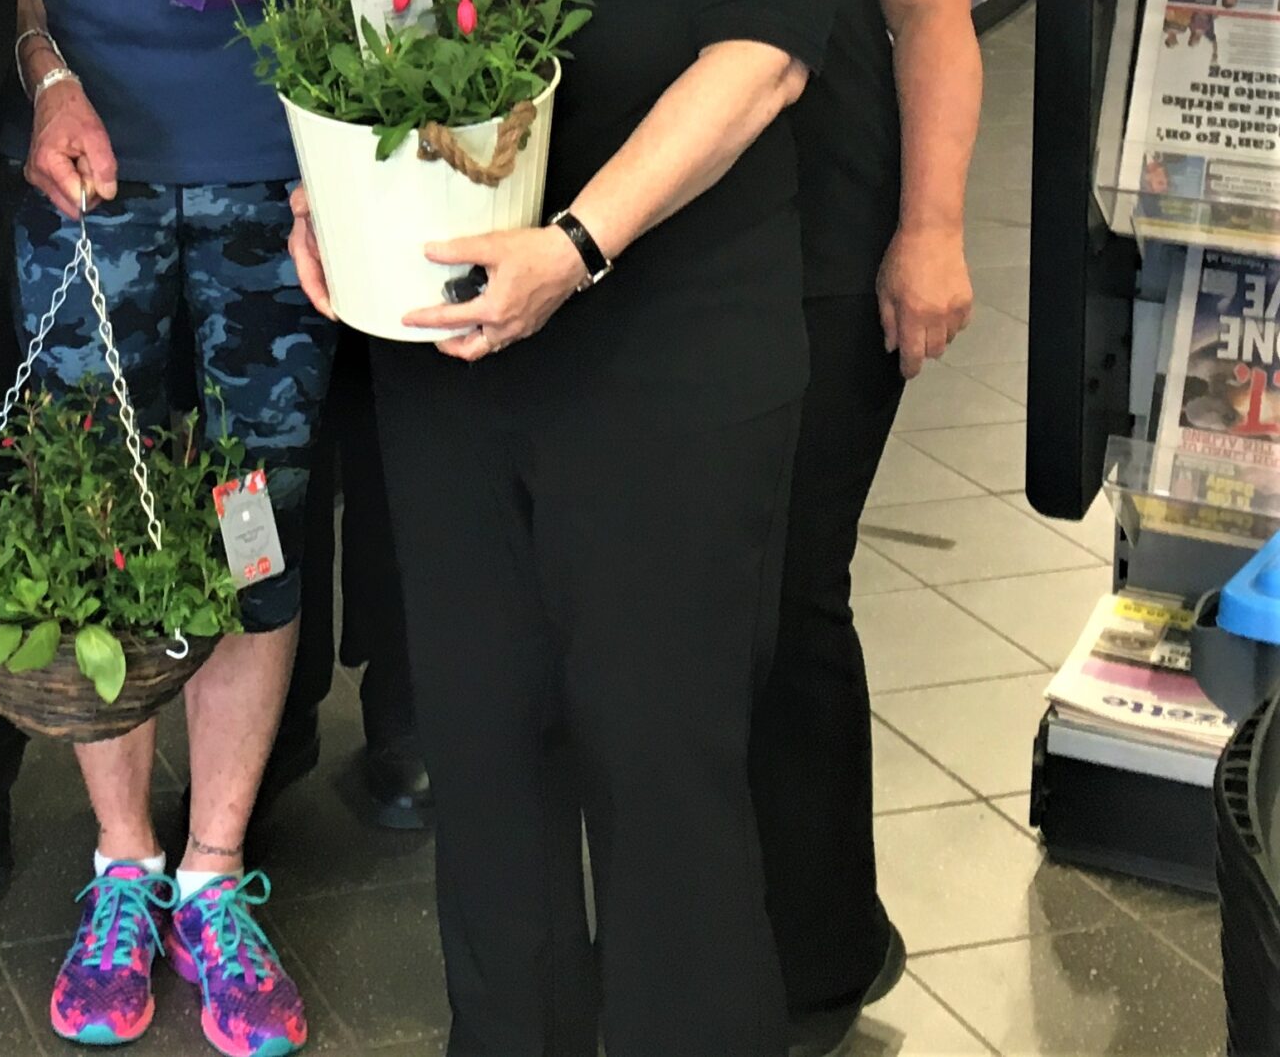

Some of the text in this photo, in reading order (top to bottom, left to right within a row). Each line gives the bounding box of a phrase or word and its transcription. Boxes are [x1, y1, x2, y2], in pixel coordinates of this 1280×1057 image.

[1208, 64, 1280, 85] acklog
[1190, 81, 1230, 100] hits
[1162, 94, 1224, 113] strike
[1228, 101, 1251, 115] as
[1181, 113, 1280, 137] eaders in
[1196, 130, 1220, 147] go
[1224, 134, 1276, 152] can't
[1217, 314, 1280, 365] NE
